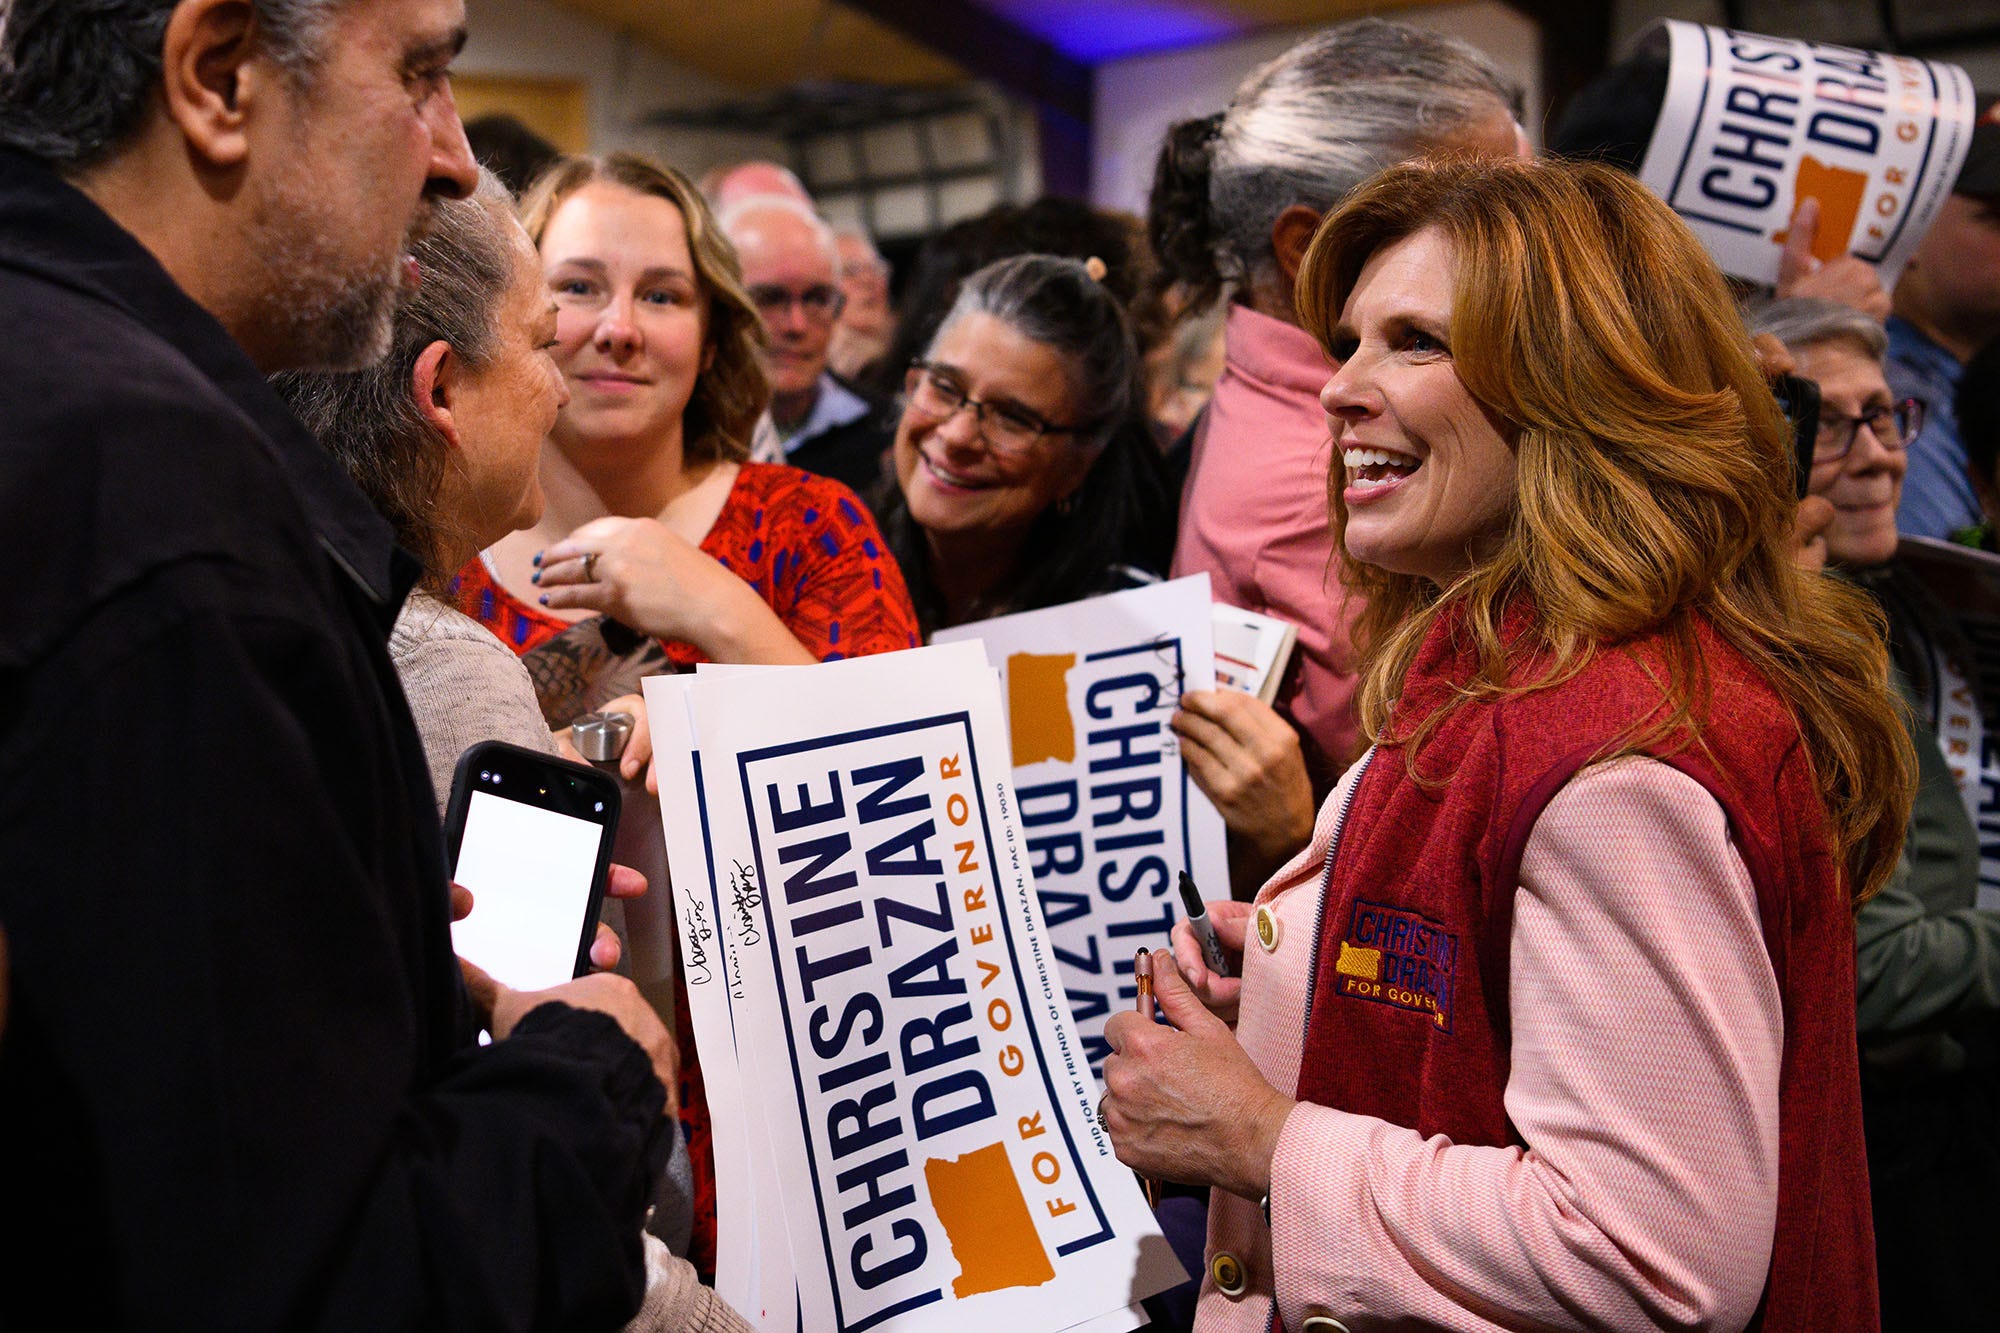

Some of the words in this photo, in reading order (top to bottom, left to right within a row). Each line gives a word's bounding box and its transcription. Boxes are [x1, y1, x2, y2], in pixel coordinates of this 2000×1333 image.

[1868, 166, 1909, 240] FOR
[996, 782, 1010, 821] 19050
[1008, 846, 1020, 871] PAC
[939, 752, 1025, 1077] GOVERNOR
[850, 755, 998, 1142] DRAZAN
[1029, 935, 1053, 1000] CHRISTINE
[1346, 979, 1381, 998] FOR
[766, 769, 928, 1290] CHRISTINE
[1048, 1004, 1060, 1021] OF
[1054, 1023, 1078, 1077] FRIENDS
[1071, 1080, 1085, 1096] BY
[1079, 1098, 1095, 1124] FOR
[1017, 1109, 1077, 1218] FOR
[1090, 1126, 1109, 1157] PAID
